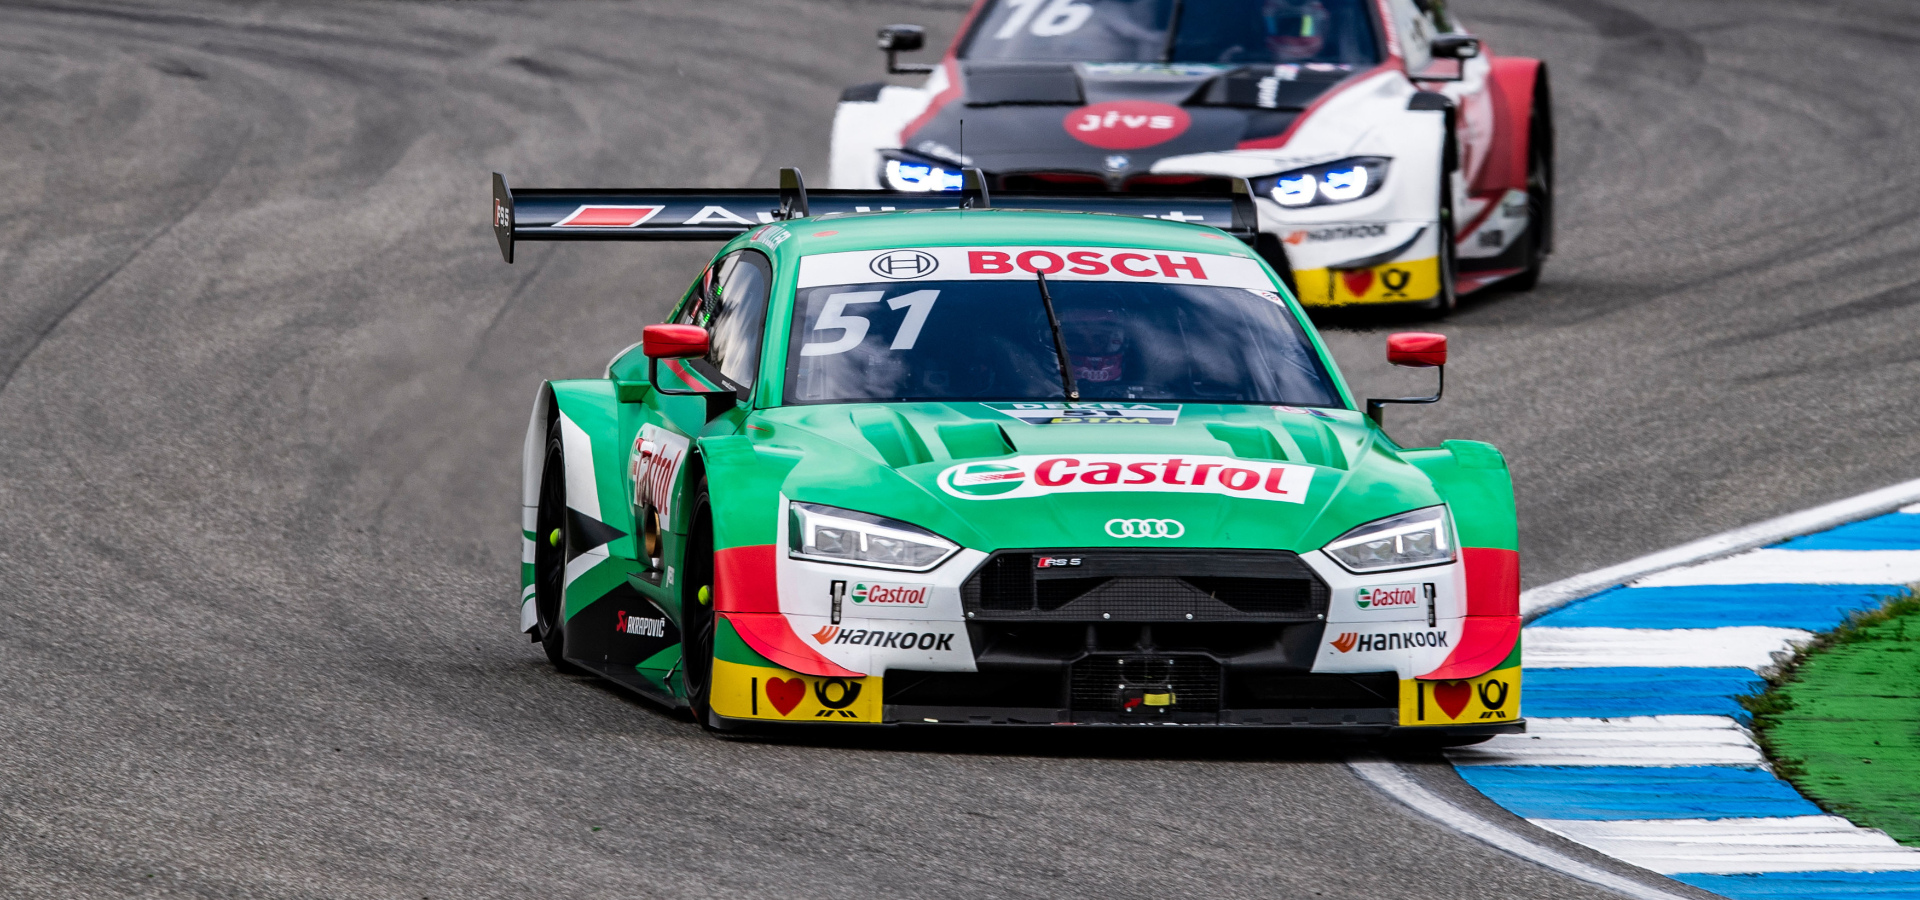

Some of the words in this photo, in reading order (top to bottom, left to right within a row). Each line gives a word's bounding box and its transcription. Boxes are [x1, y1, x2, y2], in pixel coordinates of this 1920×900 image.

[994, 0, 1093, 38] 16
[967, 250, 1209, 280] BOSCH
[801, 289, 941, 357] 51
[1012, 403, 1161, 411] DEKRA
[1050, 416, 1150, 424] DTM
[1034, 457, 1289, 495] Castrol
[868, 584, 927, 604] Castrol
[1372, 587, 1417, 607] Castrol
